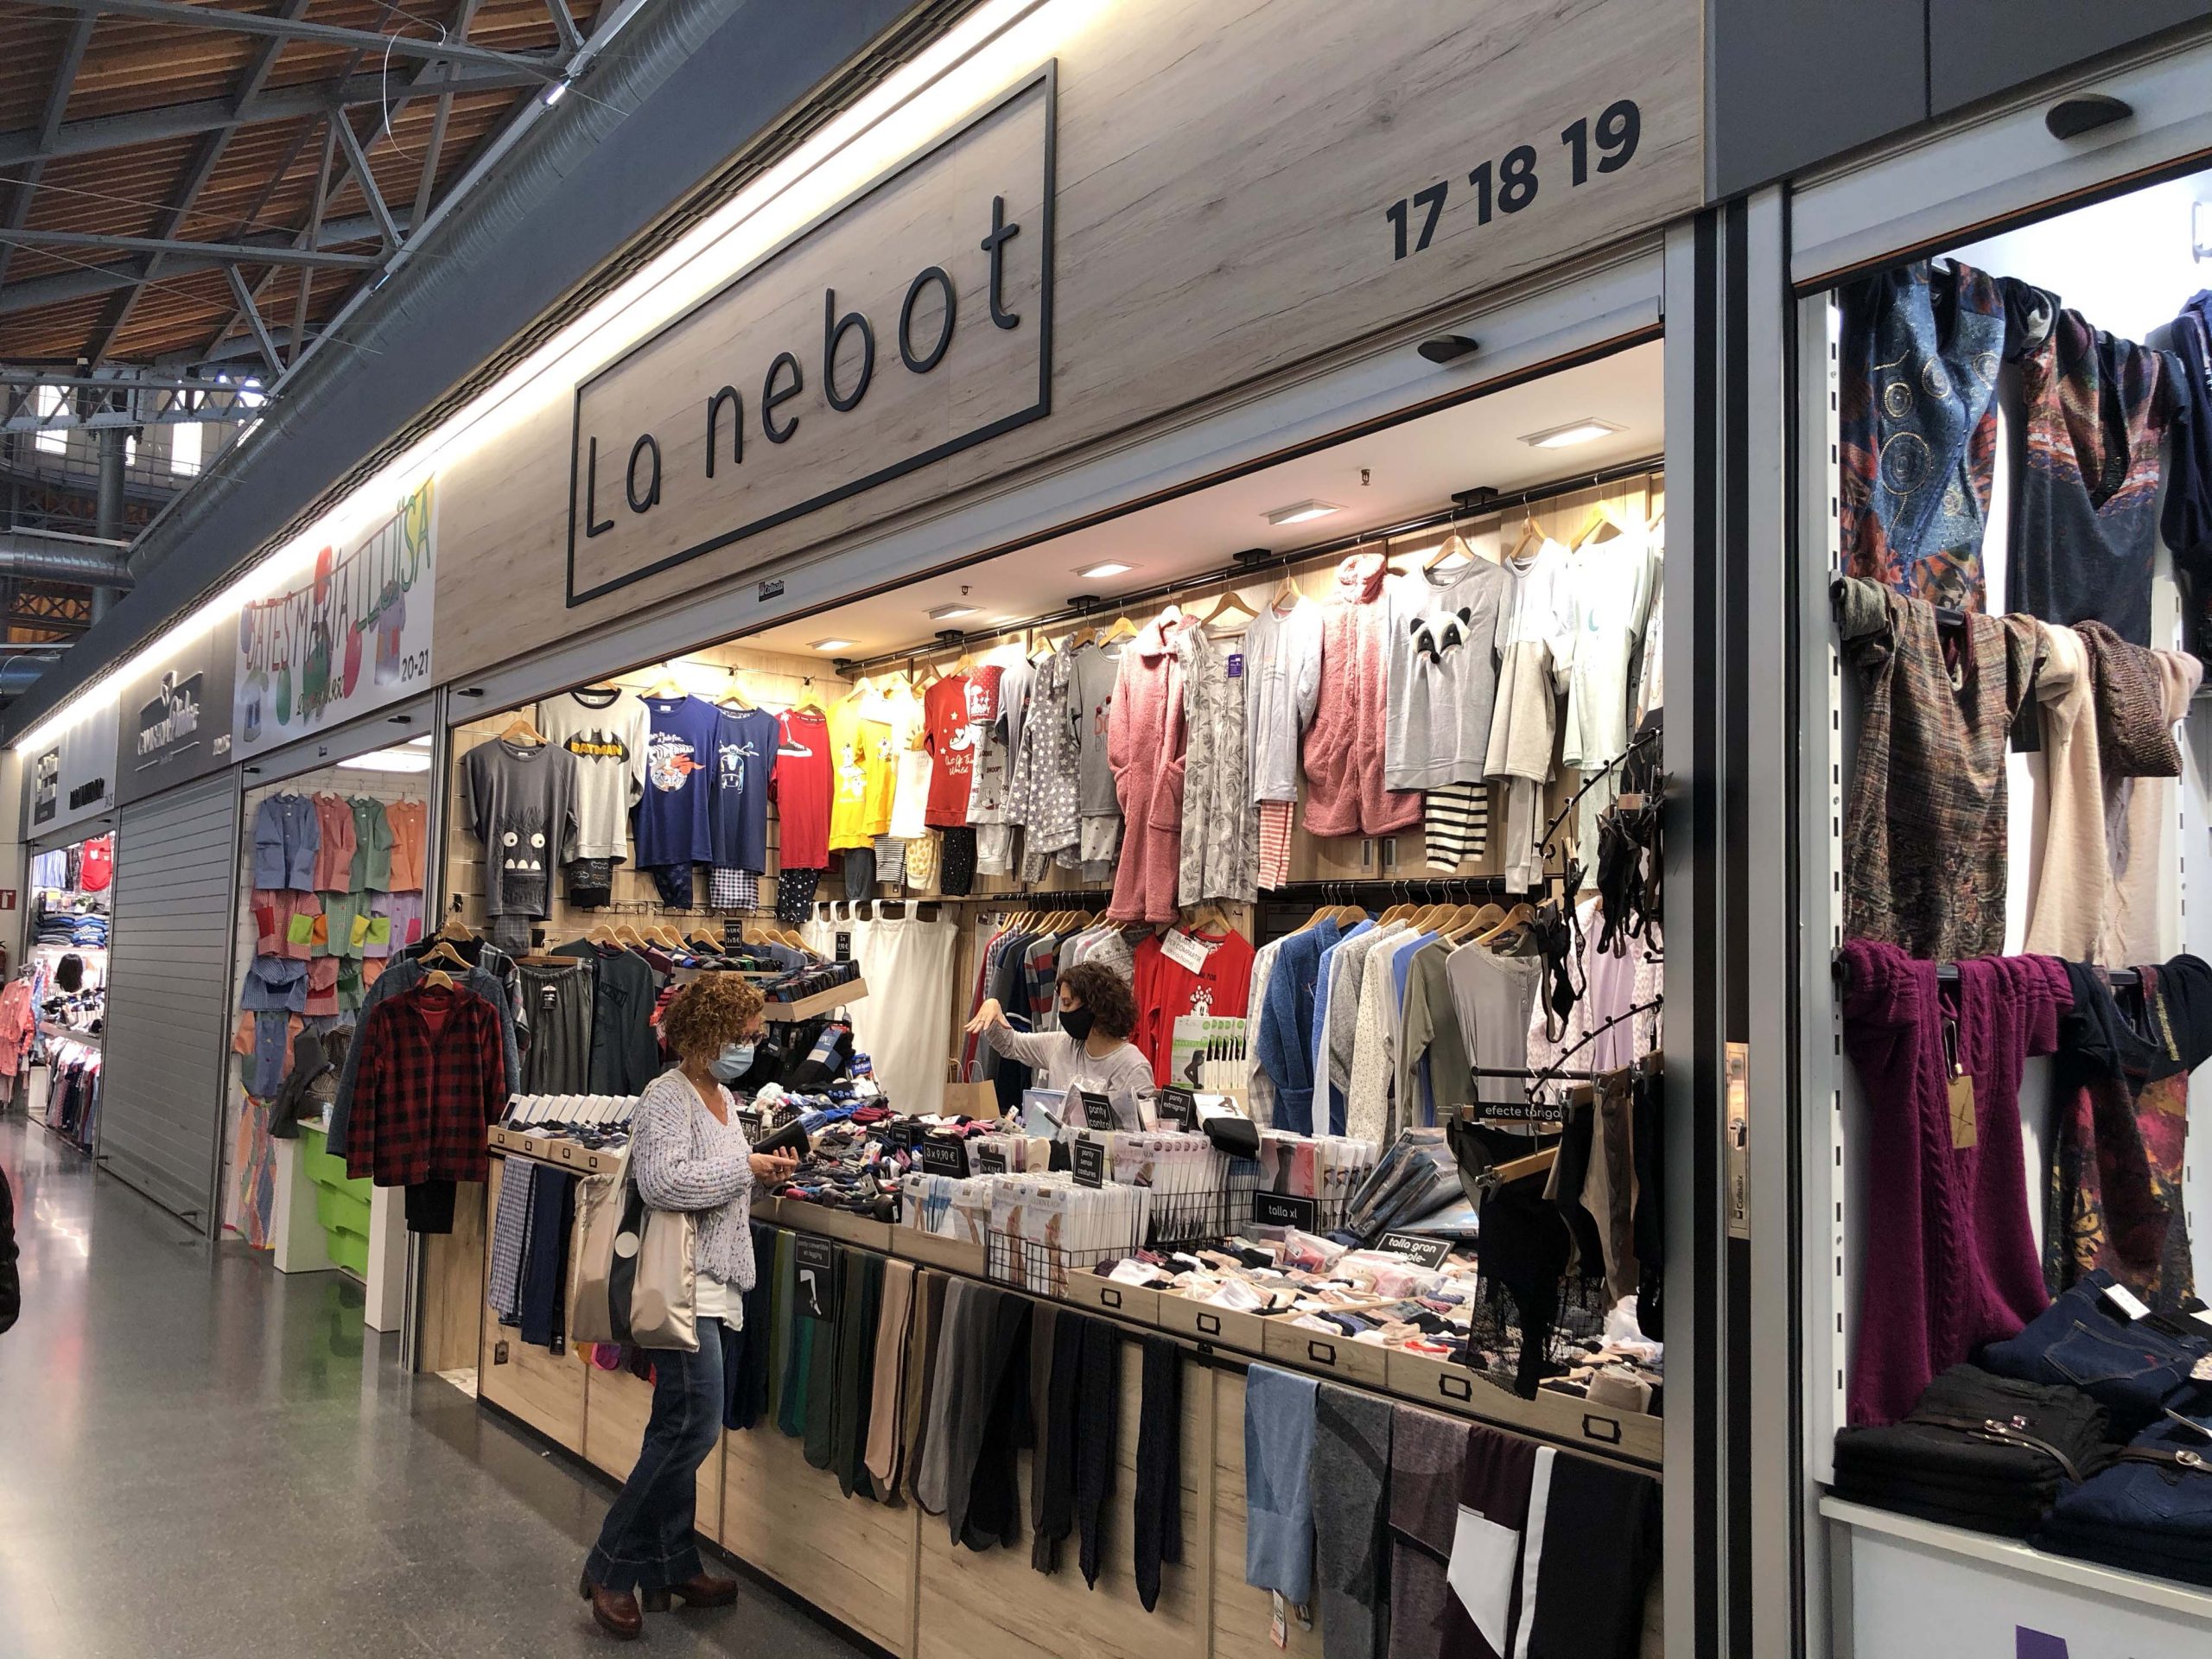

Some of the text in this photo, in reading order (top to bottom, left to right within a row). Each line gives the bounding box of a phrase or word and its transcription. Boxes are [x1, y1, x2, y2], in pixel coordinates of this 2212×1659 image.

[1386, 99, 1641, 261] 17 18 19
[587, 195, 1020, 538] La nebot
[402, 649, 429, 683] 20-21
[570, 741, 623, 756] BATMAN
[949, 766, 969, 776] World
[1168, 1094, 1183, 1103] panty
[1089, 1105, 1107, 1118] panty
[1163, 1101, 1186, 1112] extragran
[1485, 1104, 1522, 1116] efecte
[1089, 1118, 1113, 1129] control
[926, 1147, 931, 1158] 3
[936, 1149, 949, 1161] 9,90
[950, 1151, 956, 1162] €
[1081, 1149, 1094, 1158] panty
[1080, 1159, 1093, 1167] sense
[1077, 1169, 1096, 1178] costures
[1268, 1204, 1298, 1219] talla xl
[1389, 1236, 1437, 1253] talla gran
